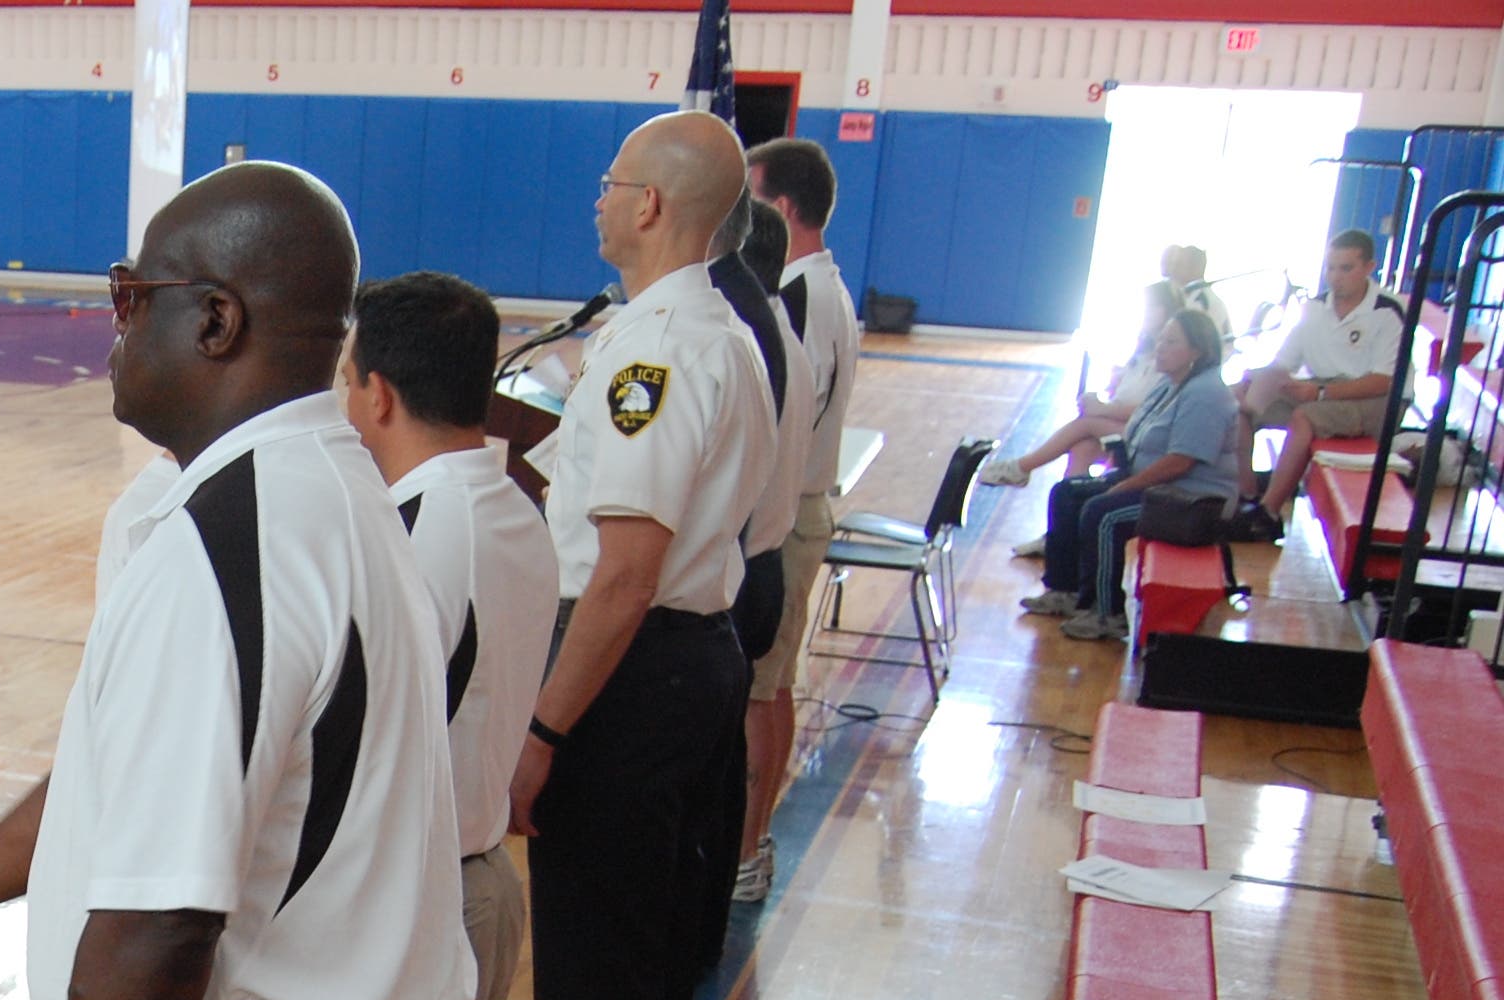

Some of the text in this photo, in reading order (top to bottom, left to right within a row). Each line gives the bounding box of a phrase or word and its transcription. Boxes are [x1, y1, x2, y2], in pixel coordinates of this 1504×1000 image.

[91, 63, 103, 77] 4
[267, 64, 279, 82] 5
[451, 67, 464, 85] 6
[648, 72, 661, 89] 7
[856, 78, 870, 97] 8
[1087, 83, 1102, 102] 9
[612, 368, 663, 387] POLICE
